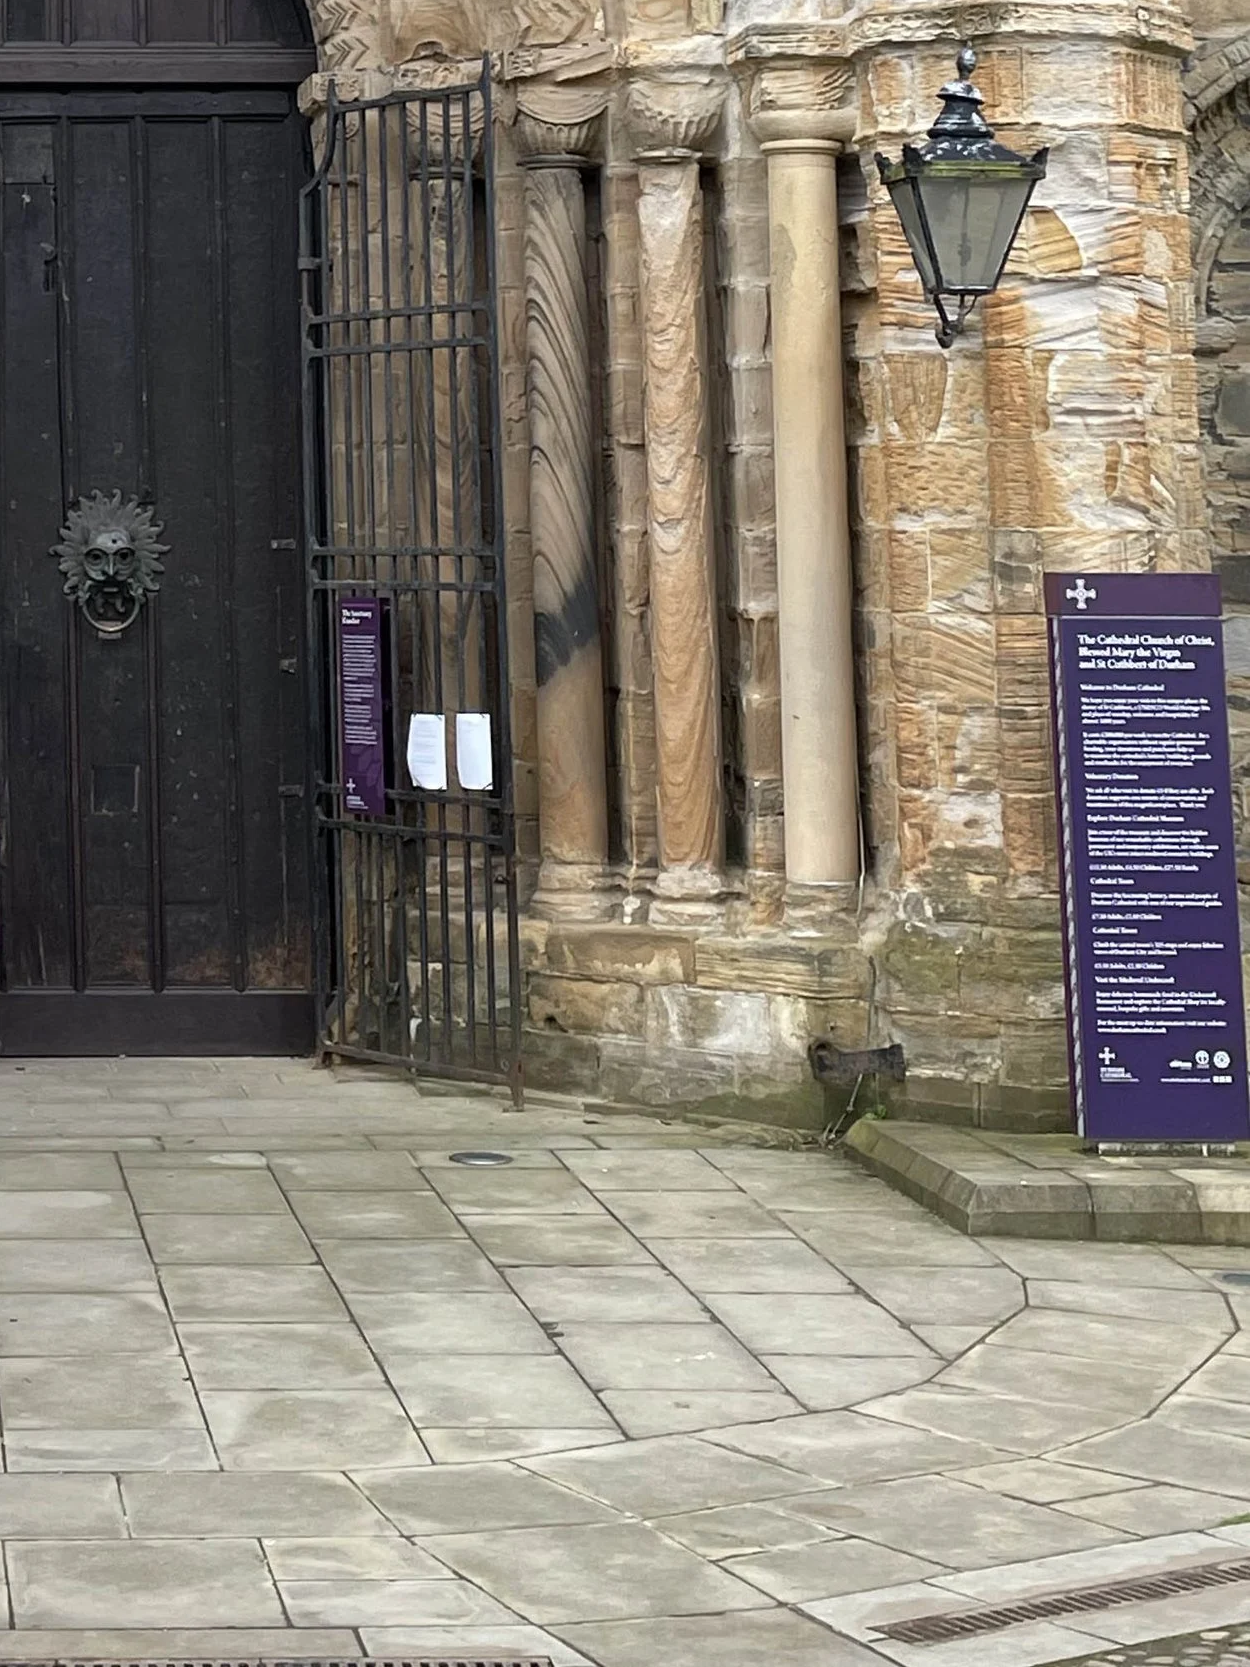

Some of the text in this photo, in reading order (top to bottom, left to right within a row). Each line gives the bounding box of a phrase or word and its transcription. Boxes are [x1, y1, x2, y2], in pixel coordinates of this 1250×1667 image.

[1077, 635, 1095, 644] The
[1097, 635, 1139, 645] Cathedral
[1141, 635, 1173, 645] Church
[1175, 635, 1184, 645] of
[1078, 647, 1181, 659] Blessed Mary the Virgin
[1079, 660, 1196, 669] and St Cuthbert of Durham
